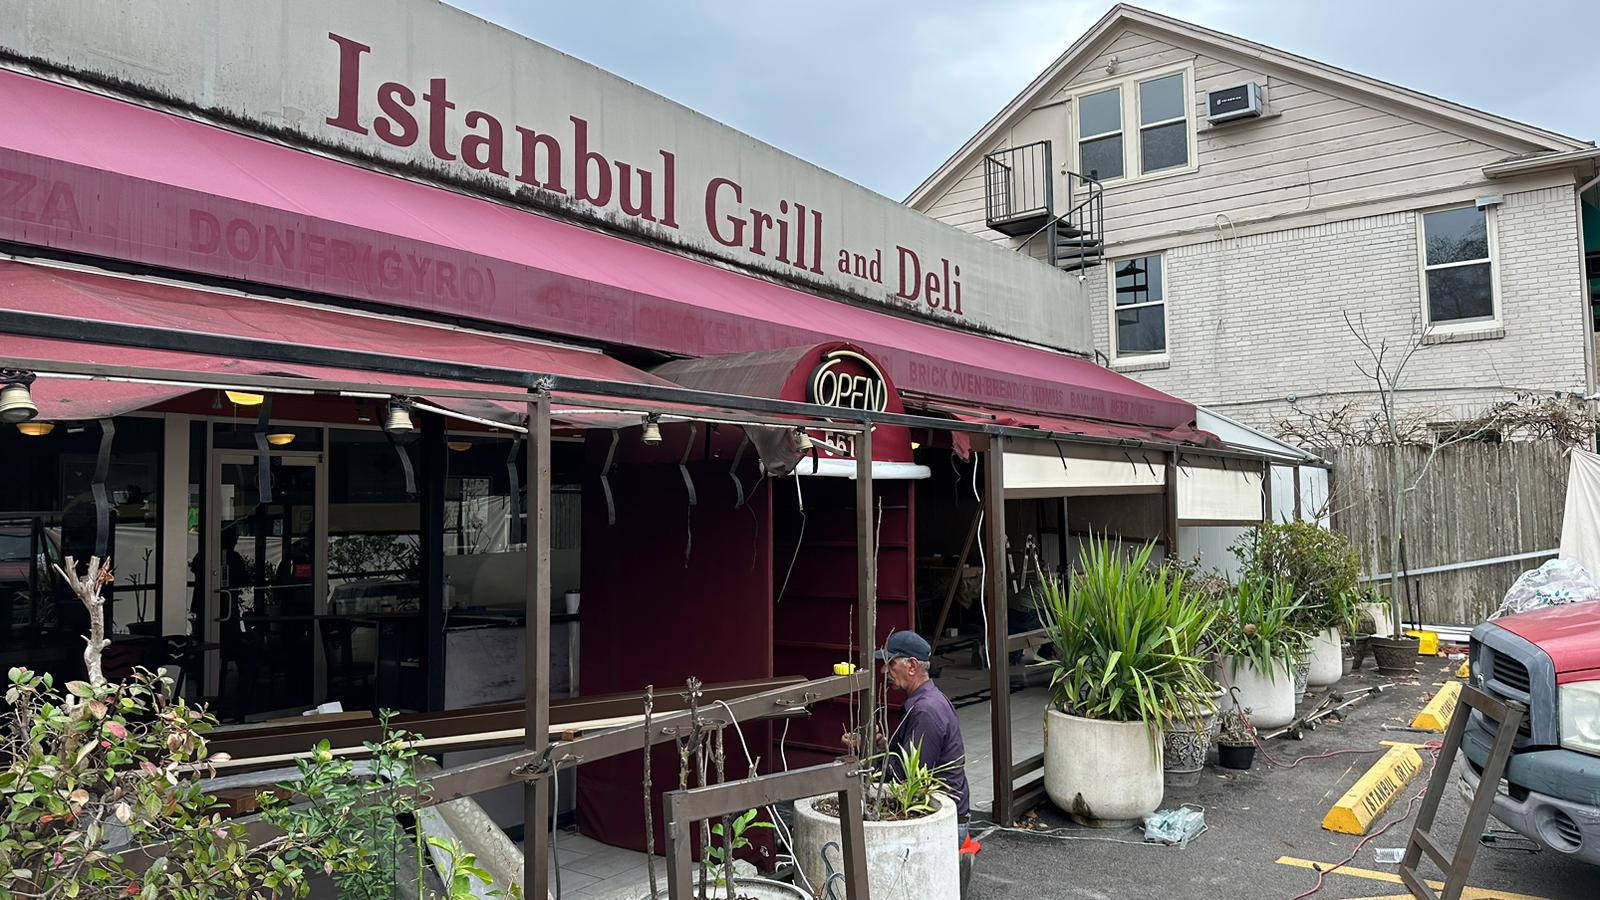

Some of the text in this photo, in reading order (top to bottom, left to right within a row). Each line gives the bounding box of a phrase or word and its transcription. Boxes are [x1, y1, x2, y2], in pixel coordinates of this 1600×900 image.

[325, 31, 964, 316] Istanbul Grill and Deli
[189, 208, 361, 283] DONER
[819, 370, 882, 412] OPEN
[909, 360, 948, 388] BRICK
[950, 367, 982, 396] OVEN
[1361, 757, 1417, 817] ISTANBUL GRILL
